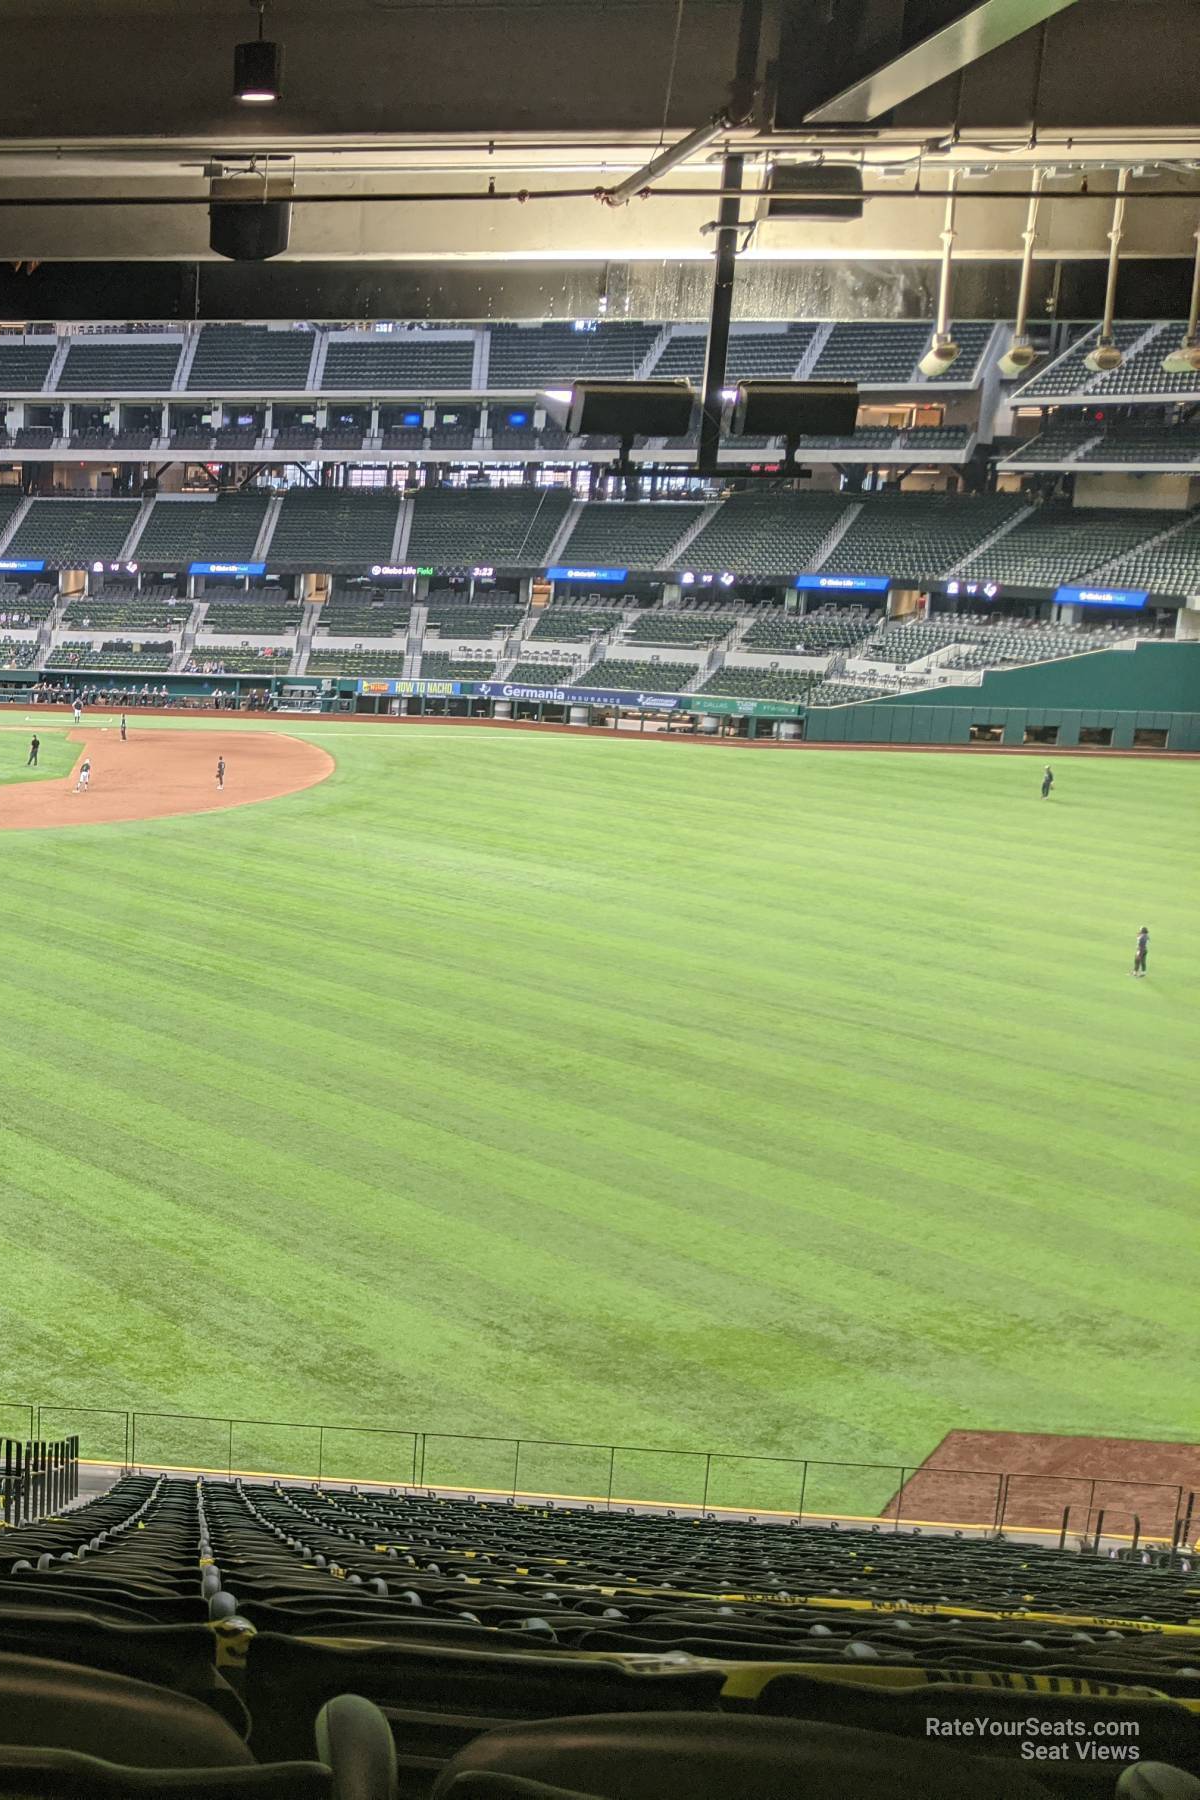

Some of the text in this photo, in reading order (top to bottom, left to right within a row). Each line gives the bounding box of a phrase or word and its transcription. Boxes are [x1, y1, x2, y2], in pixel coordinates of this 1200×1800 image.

[382, 567, 433, 575] Globe Life Field
[395, 681, 414, 694] HOW
[416, 681, 425, 695] TO
[502, 684, 565, 701] Germania
[567, 695, 621, 704] INSURANCE
